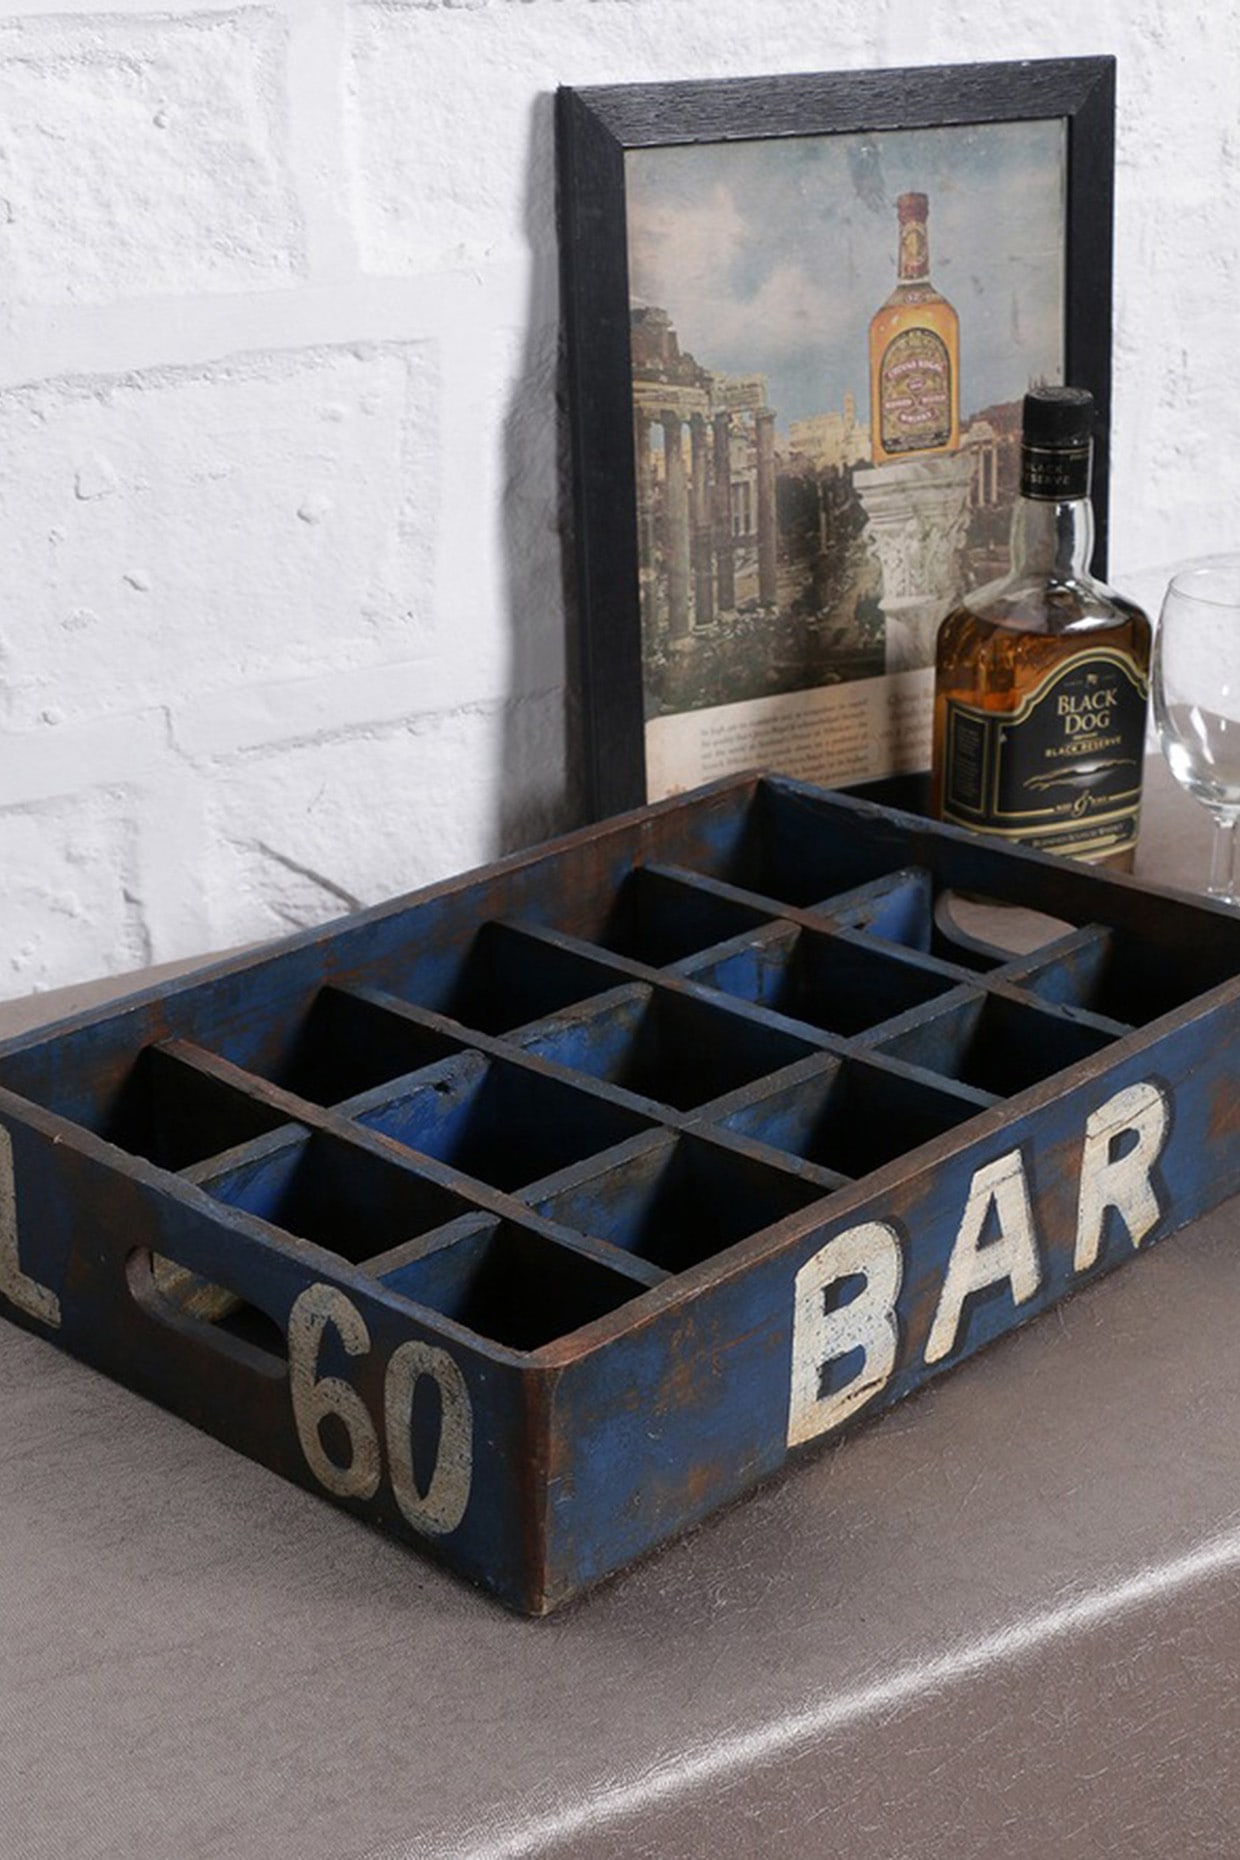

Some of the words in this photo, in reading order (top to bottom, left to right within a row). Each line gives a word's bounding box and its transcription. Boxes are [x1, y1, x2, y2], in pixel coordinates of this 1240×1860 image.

[1058, 688, 1118, 715] BLACK
[1065, 710, 1110, 734] DOG
[1045, 744, 1077, 757] BLACK
[787, 1082, 1168, 1448] BAR
[287, 1283, 473, 1535] 60
